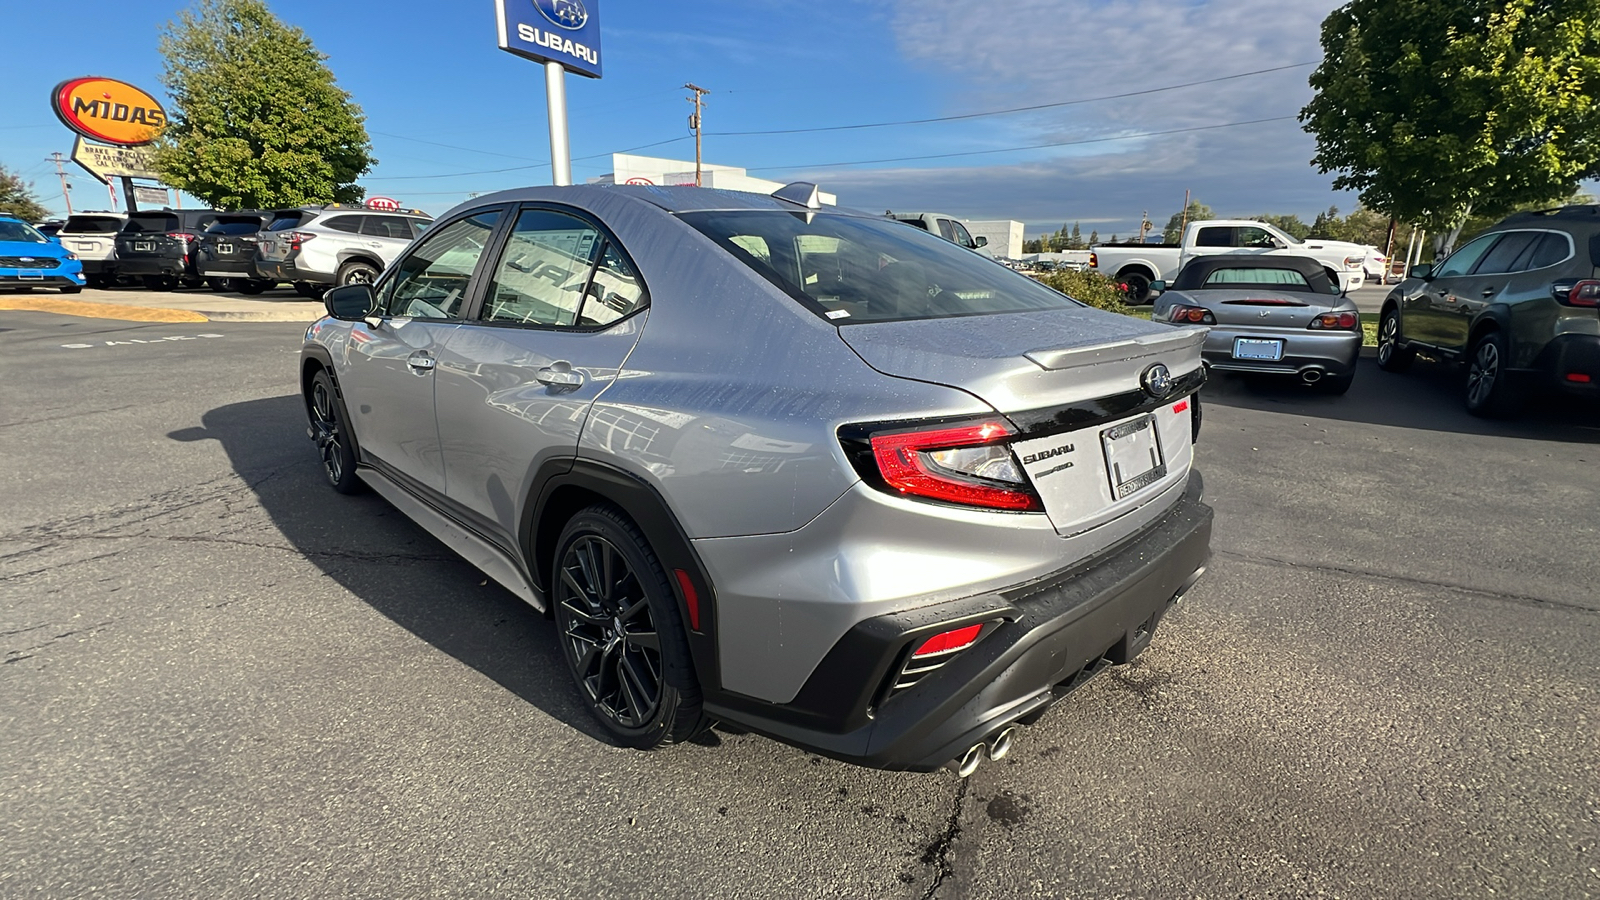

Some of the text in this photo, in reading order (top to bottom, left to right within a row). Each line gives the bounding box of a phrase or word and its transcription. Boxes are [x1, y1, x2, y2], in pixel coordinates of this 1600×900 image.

[518, 23, 597, 65] SUBARU
[73, 92, 163, 126] MIDAS
[1023, 443, 1075, 465] SUBARU
